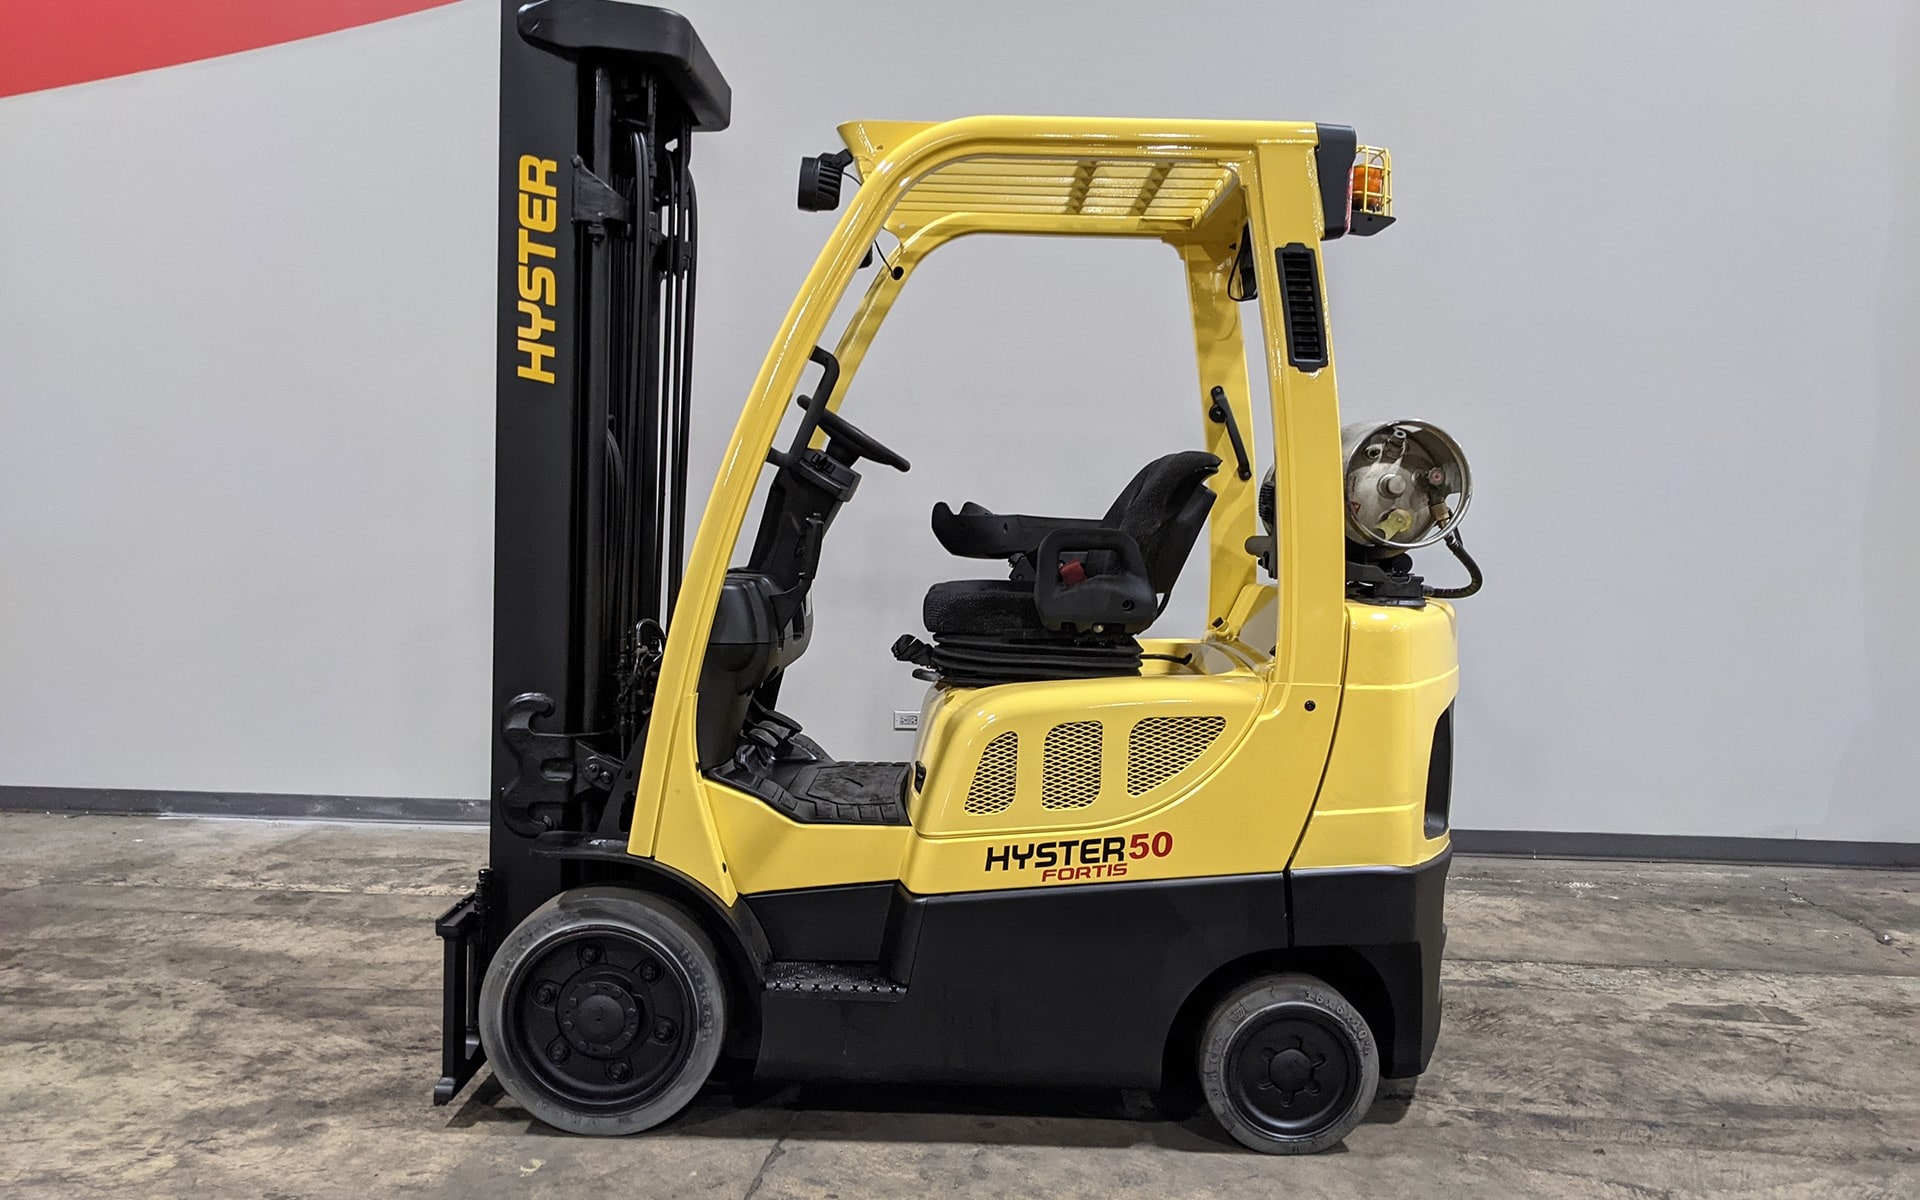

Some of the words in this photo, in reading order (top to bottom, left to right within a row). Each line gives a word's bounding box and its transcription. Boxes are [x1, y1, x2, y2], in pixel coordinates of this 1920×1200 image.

[517, 154, 557, 385] HYSTER
[984, 836, 1126, 872] HYSTER
[1129, 831, 1173, 860] 50
[1041, 863, 1128, 882] FORTIS
